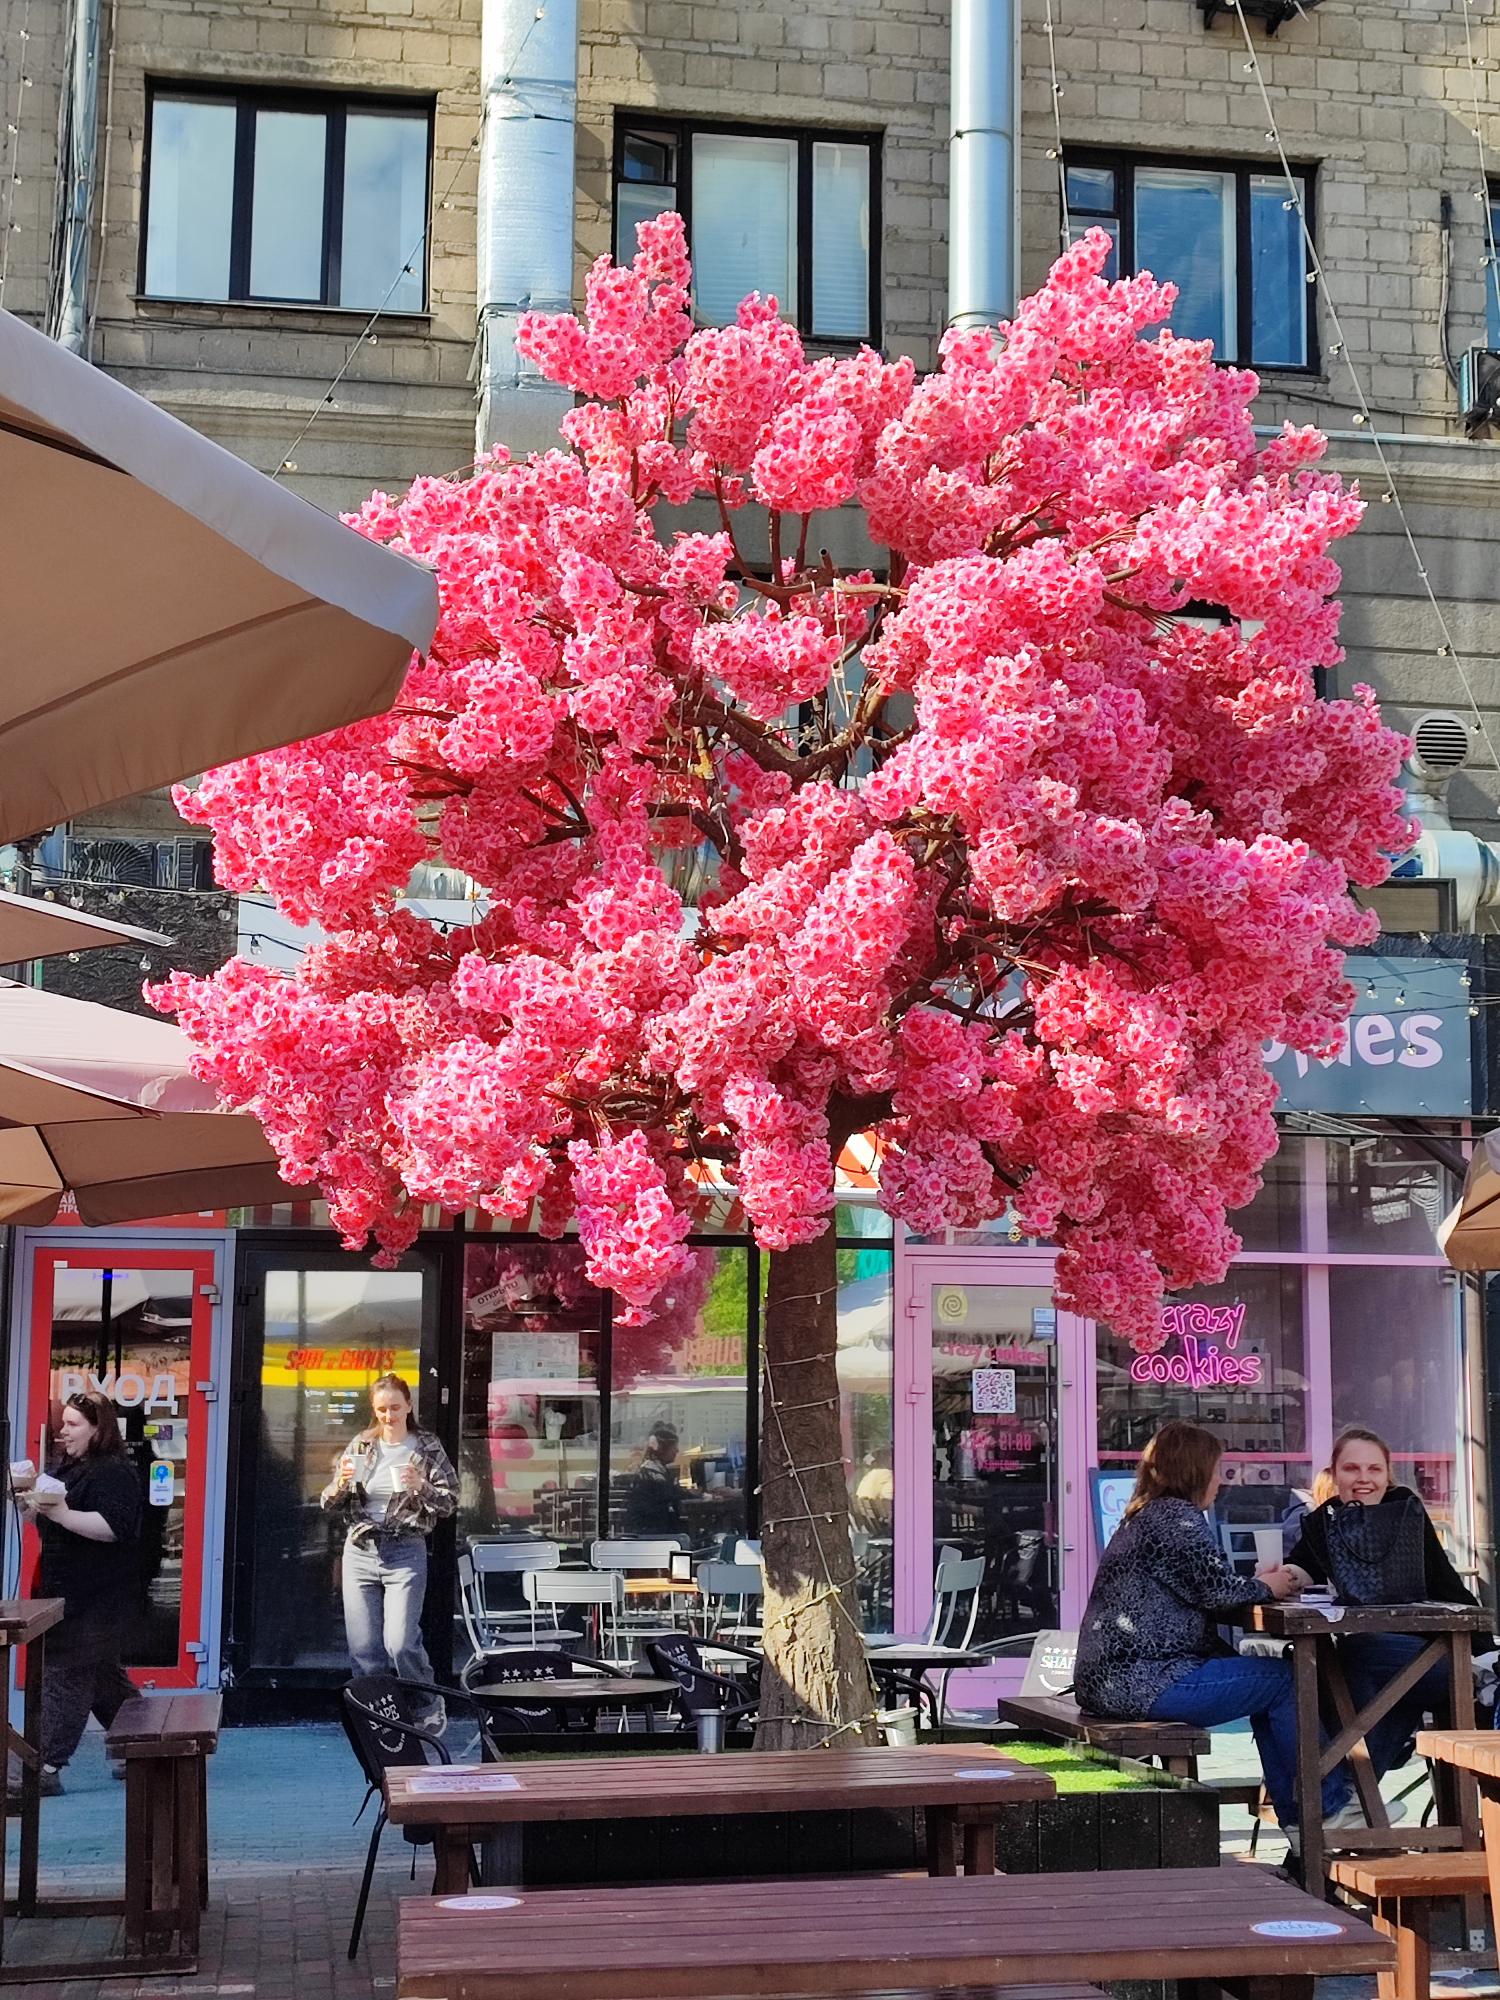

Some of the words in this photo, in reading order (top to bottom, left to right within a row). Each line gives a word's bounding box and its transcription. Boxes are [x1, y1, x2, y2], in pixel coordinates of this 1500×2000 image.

[1160, 1302, 1246, 1349] crazy
[1131, 1335, 1262, 1389] cookies
[61, 1373, 179, 1416] ВХОД
